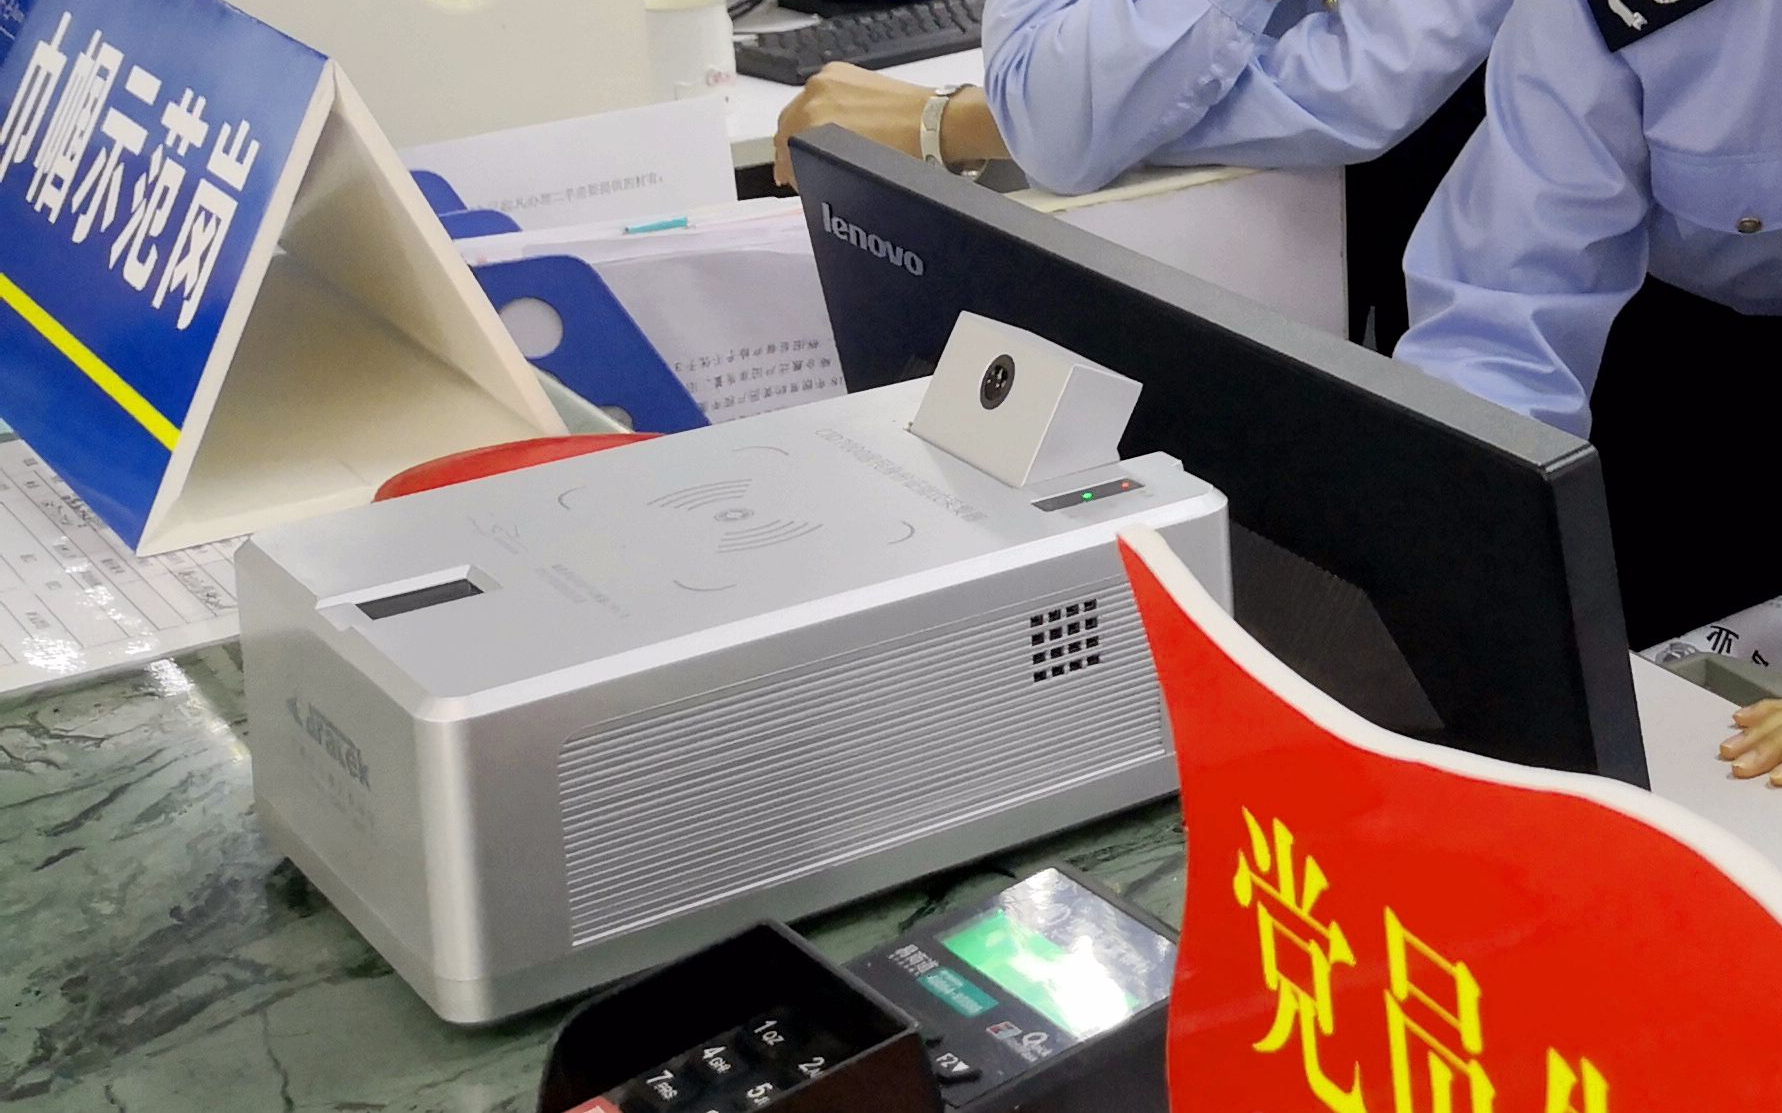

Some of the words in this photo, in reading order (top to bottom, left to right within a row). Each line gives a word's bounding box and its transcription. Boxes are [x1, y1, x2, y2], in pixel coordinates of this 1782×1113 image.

[0, 12, 260, 330] 巾帼示范岗
[821, 202, 925, 276] lenovo
[1233, 805, 1609, 1113] 党员
